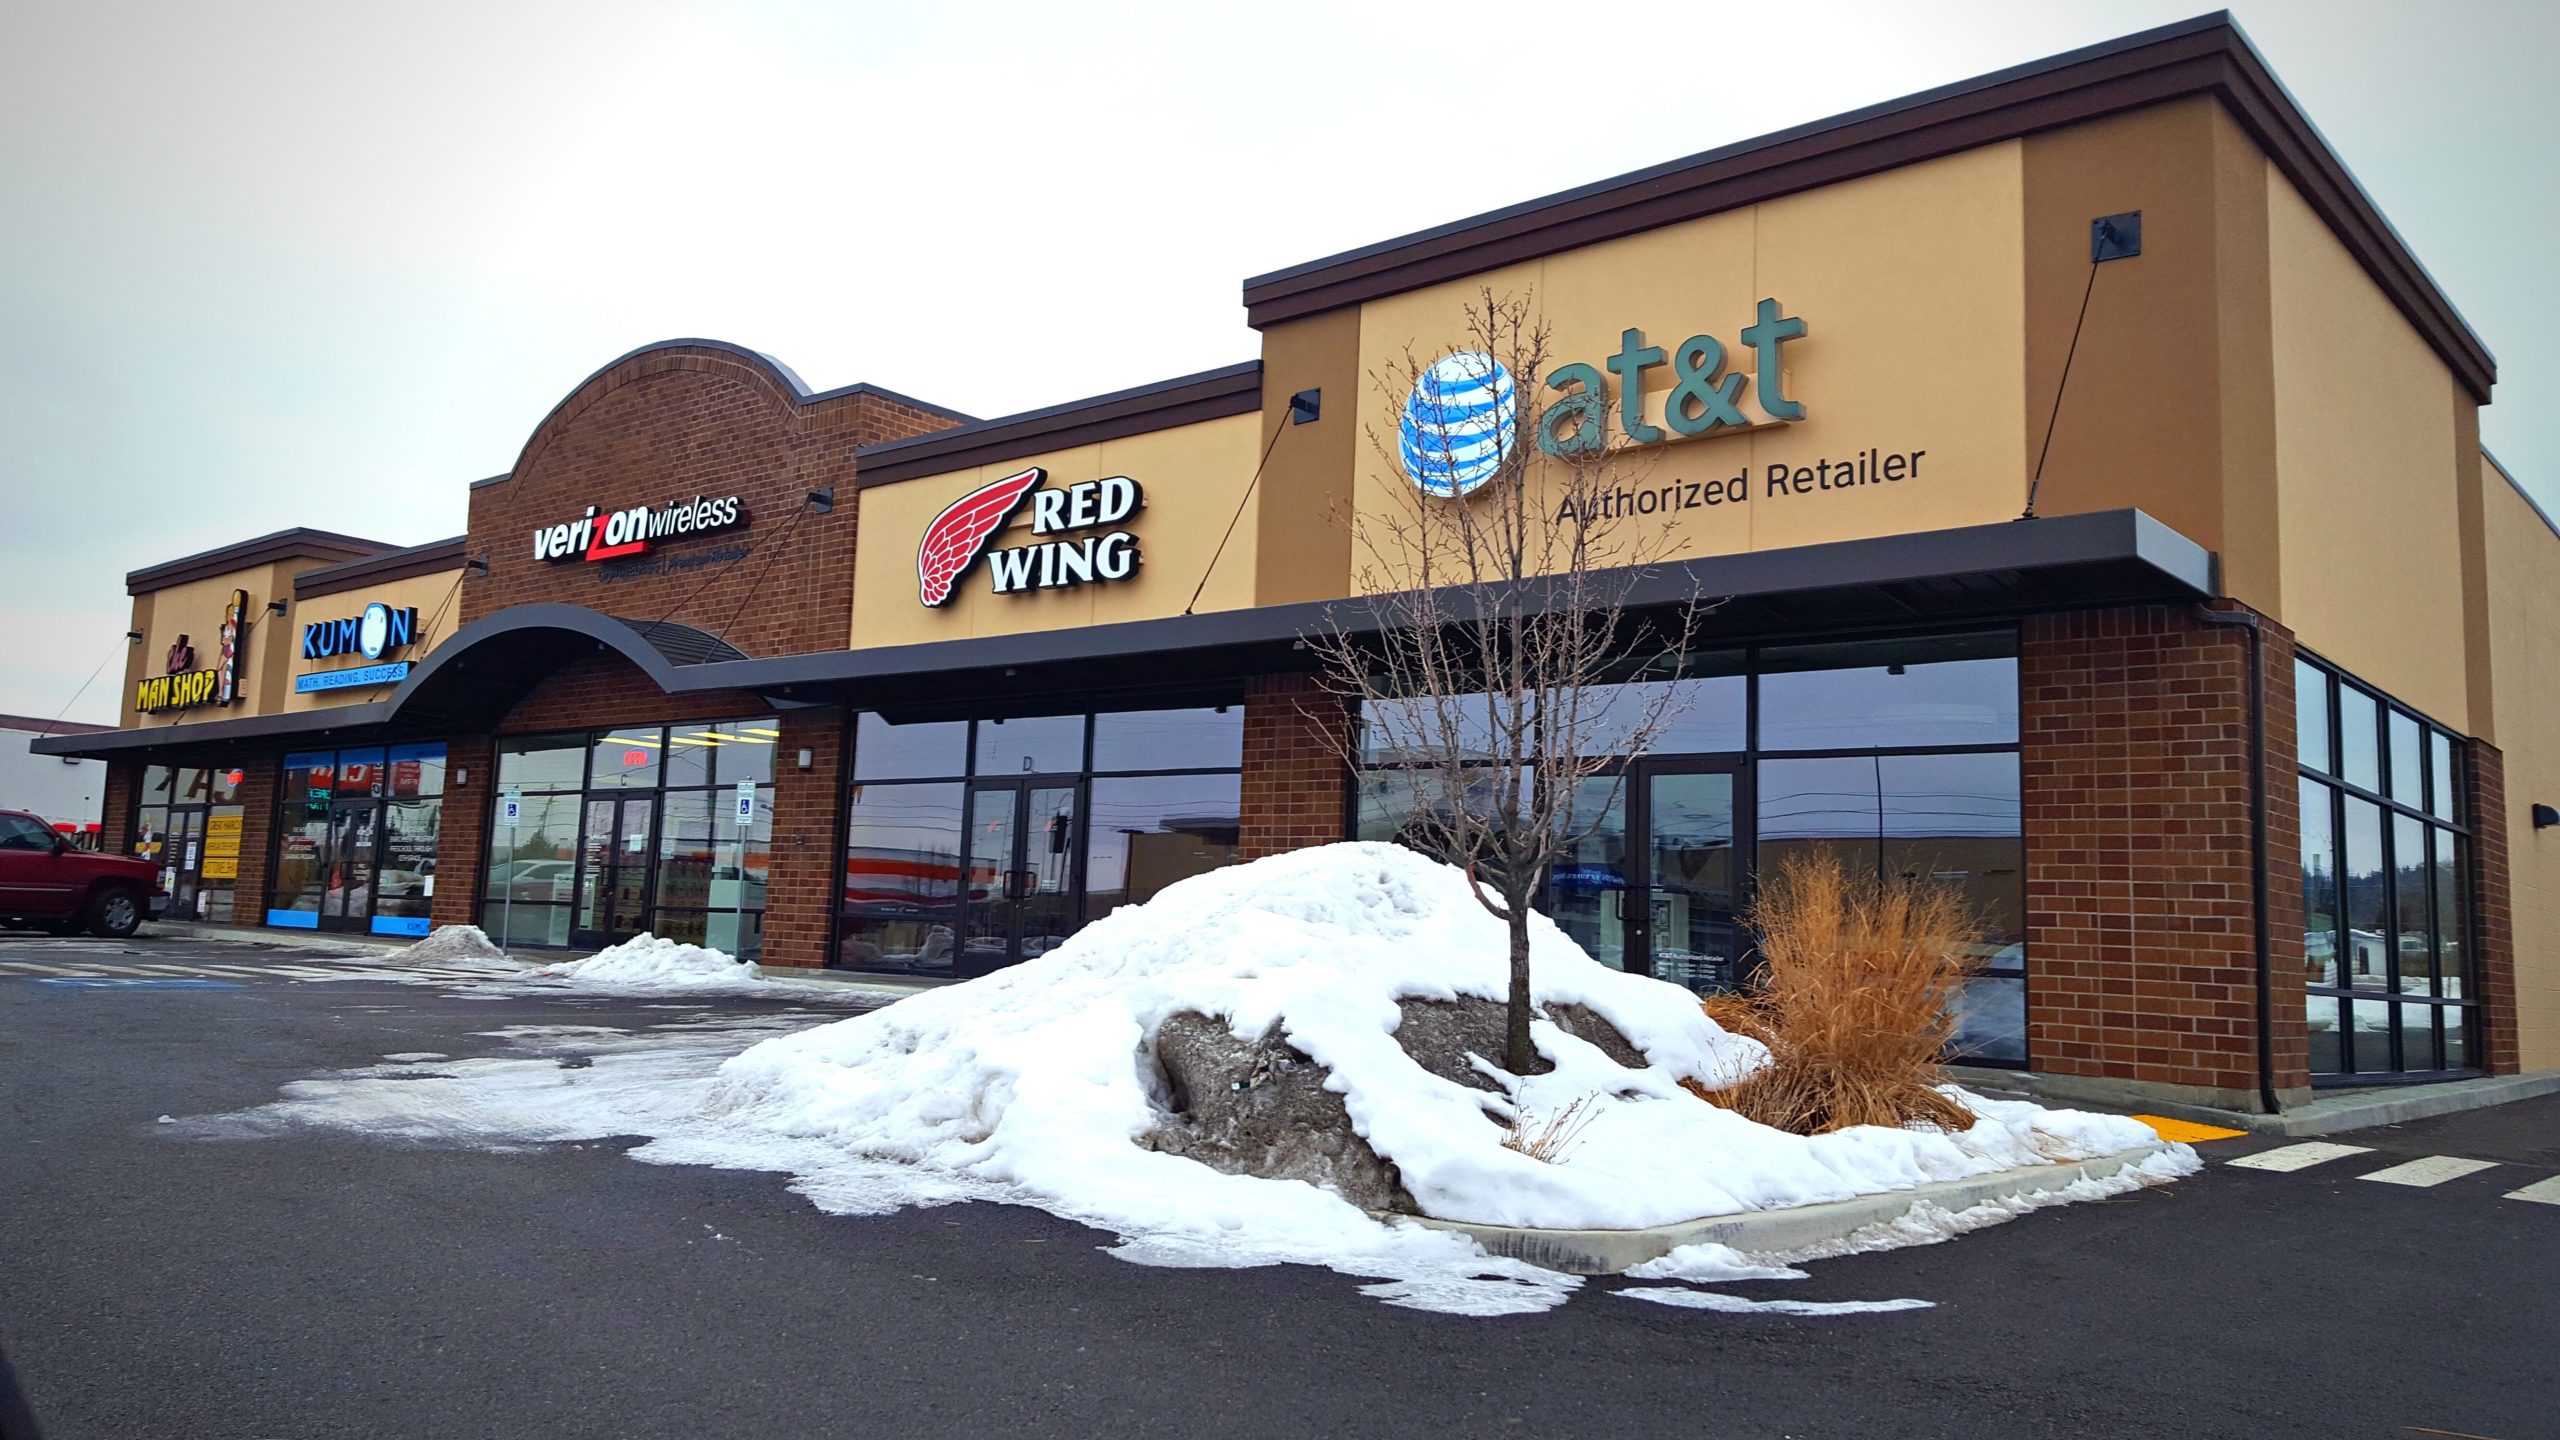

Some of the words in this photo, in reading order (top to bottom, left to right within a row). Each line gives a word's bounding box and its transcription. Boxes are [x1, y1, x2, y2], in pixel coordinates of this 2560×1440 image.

[1537, 297, 1809, 458] at&t
[1032, 476, 1136, 535] RED
[1555, 467, 1748, 526] Authorized
[1767, 448, 1927, 498] Retailer
[534, 505, 650, 562] verizon
[649, 495, 739, 539] wireless
[987, 531, 1133, 593] WING
[166, 633, 195, 674] the
[302, 602, 412, 660] KUMON
[135, 676, 170, 713] MAN
[171, 669, 216, 708] SHOP
[1022, 756, 1033, 772] D
